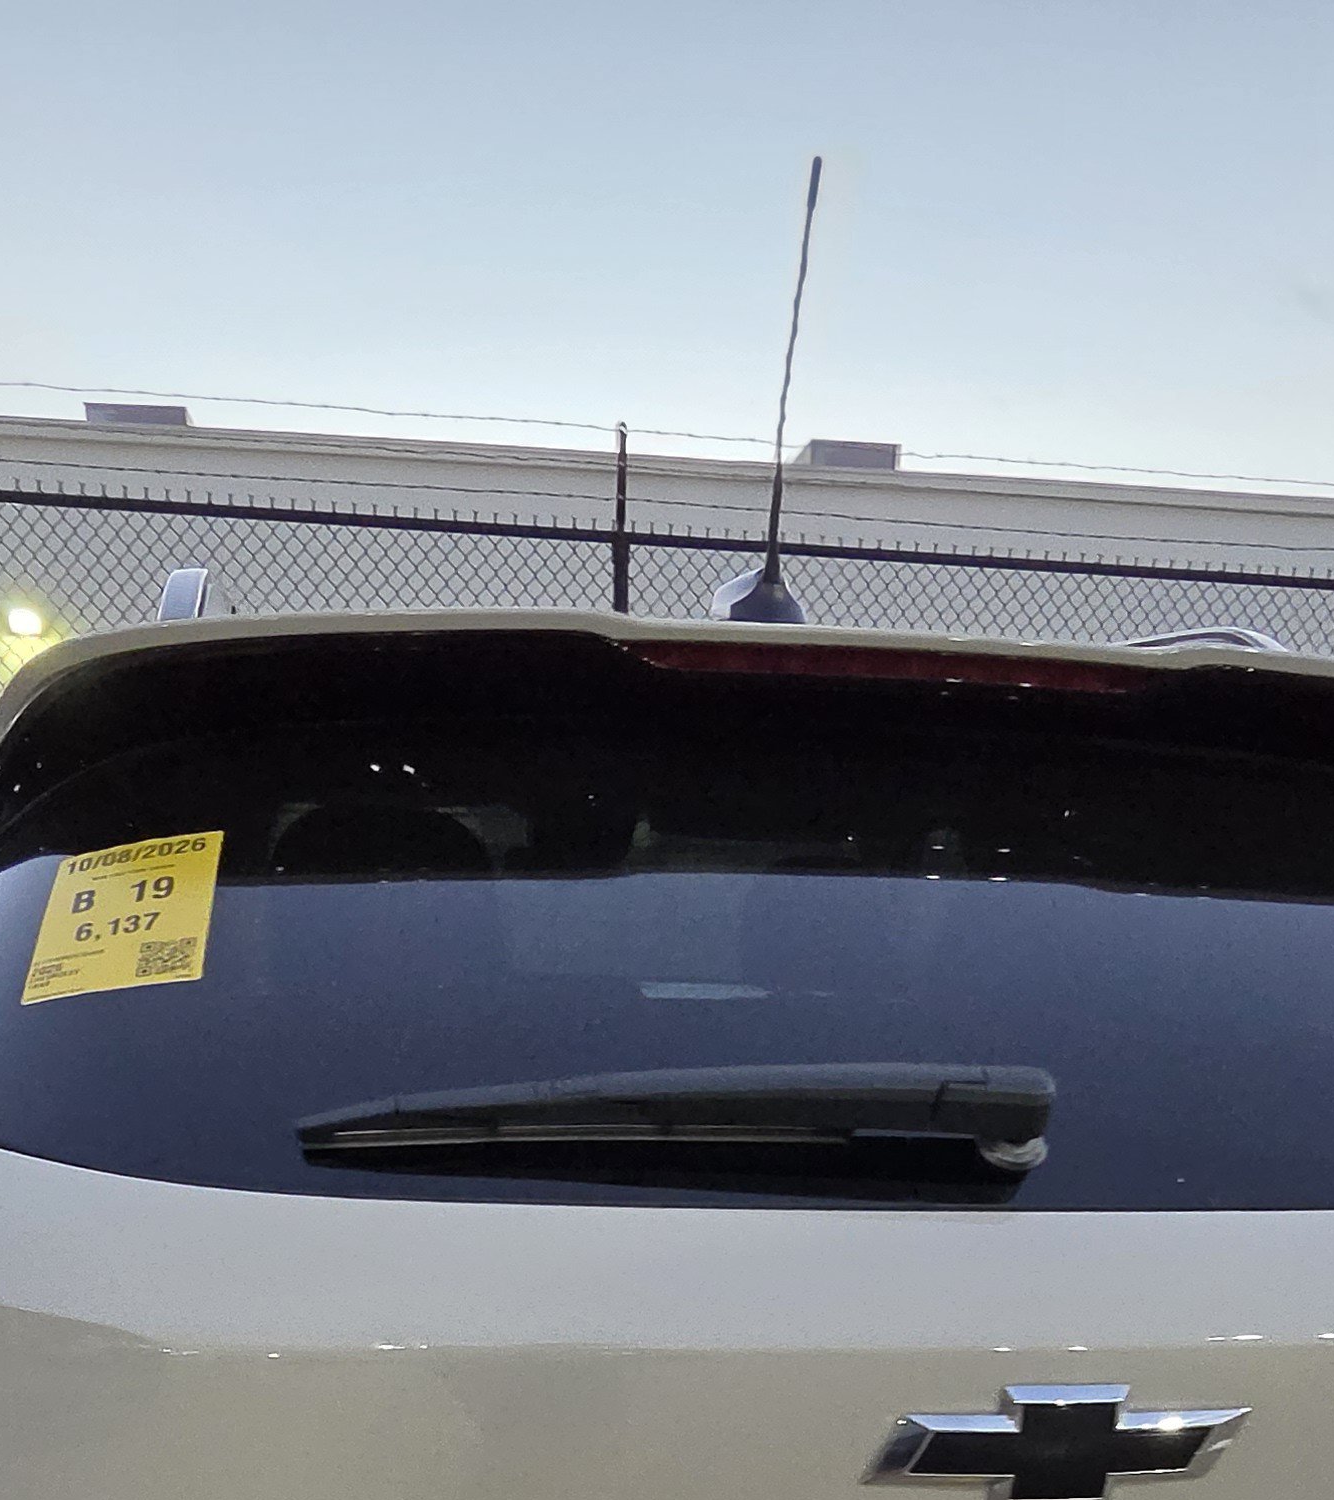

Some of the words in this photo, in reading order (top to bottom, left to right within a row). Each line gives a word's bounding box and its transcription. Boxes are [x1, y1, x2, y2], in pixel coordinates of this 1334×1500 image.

[67, 837, 207, 876] 10/08/2026
[71, 889, 96, 914] B
[130, 876, 175, 902] 19
[74, 912, 161, 942] 6,137
